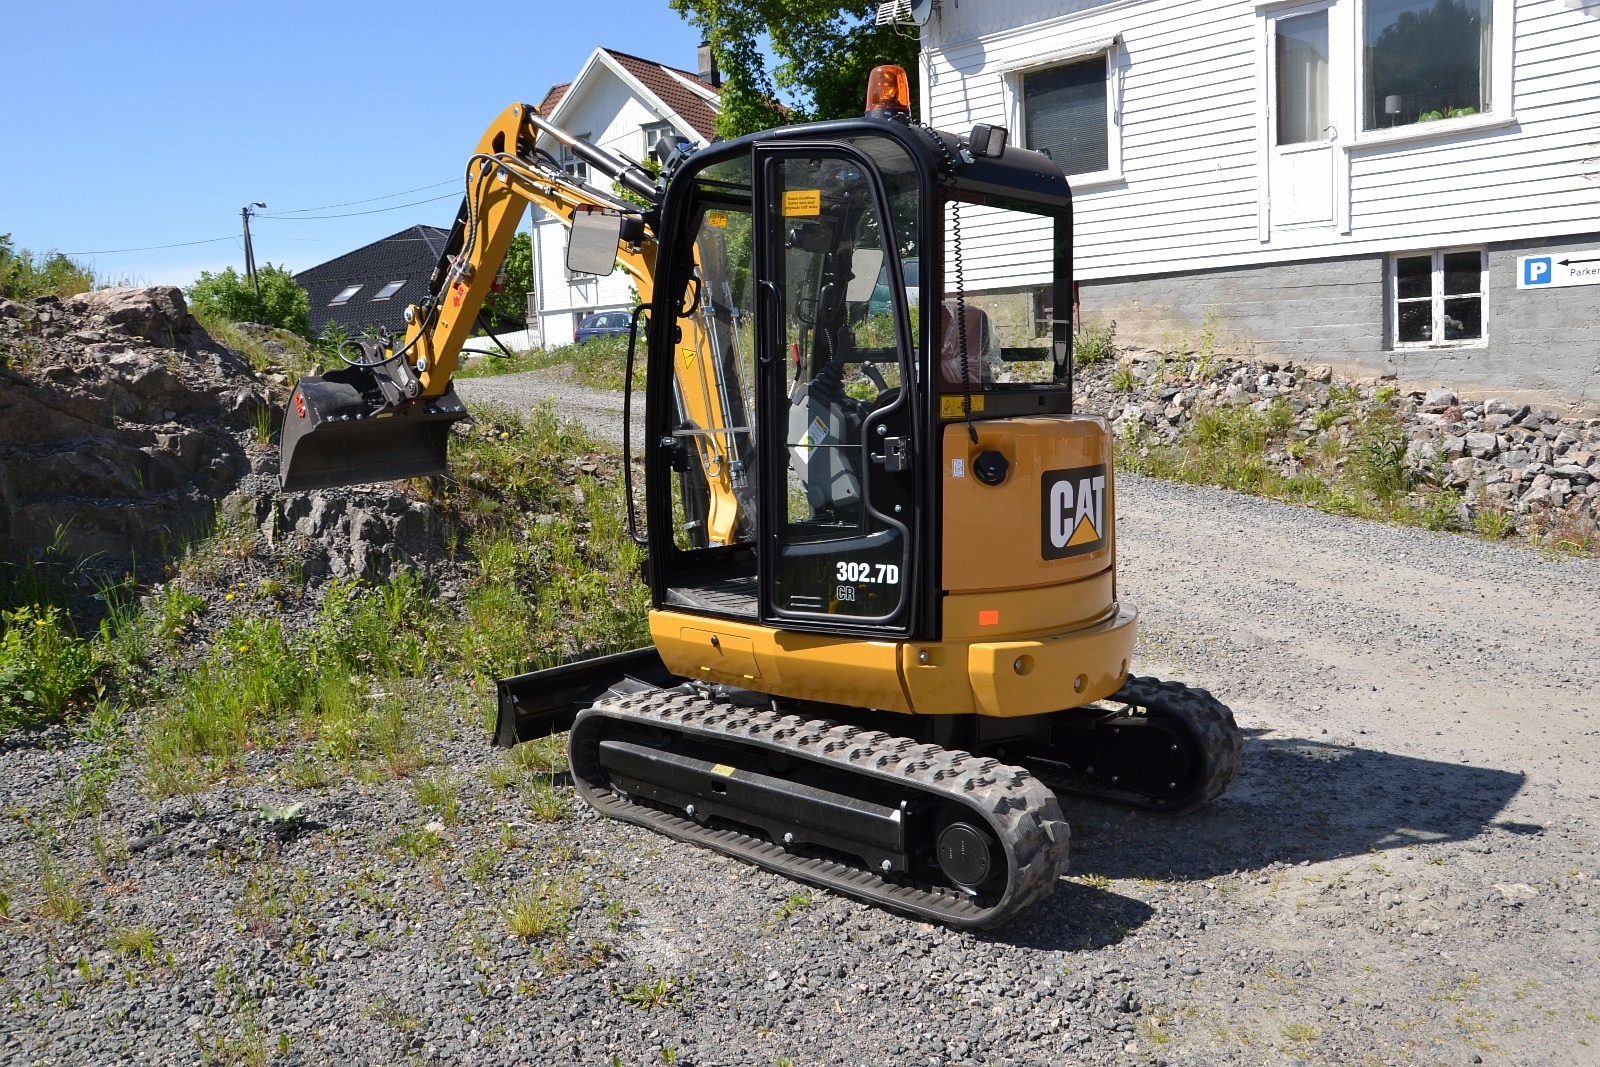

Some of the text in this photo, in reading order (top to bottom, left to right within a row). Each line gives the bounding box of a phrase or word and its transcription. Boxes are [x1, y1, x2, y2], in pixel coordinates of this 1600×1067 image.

[1530, 261, 1547, 281] P
[1050, 475, 1105, 548] CAT
[836, 561, 899, 584] 302.7D
[836, 585, 855, 601] CR
